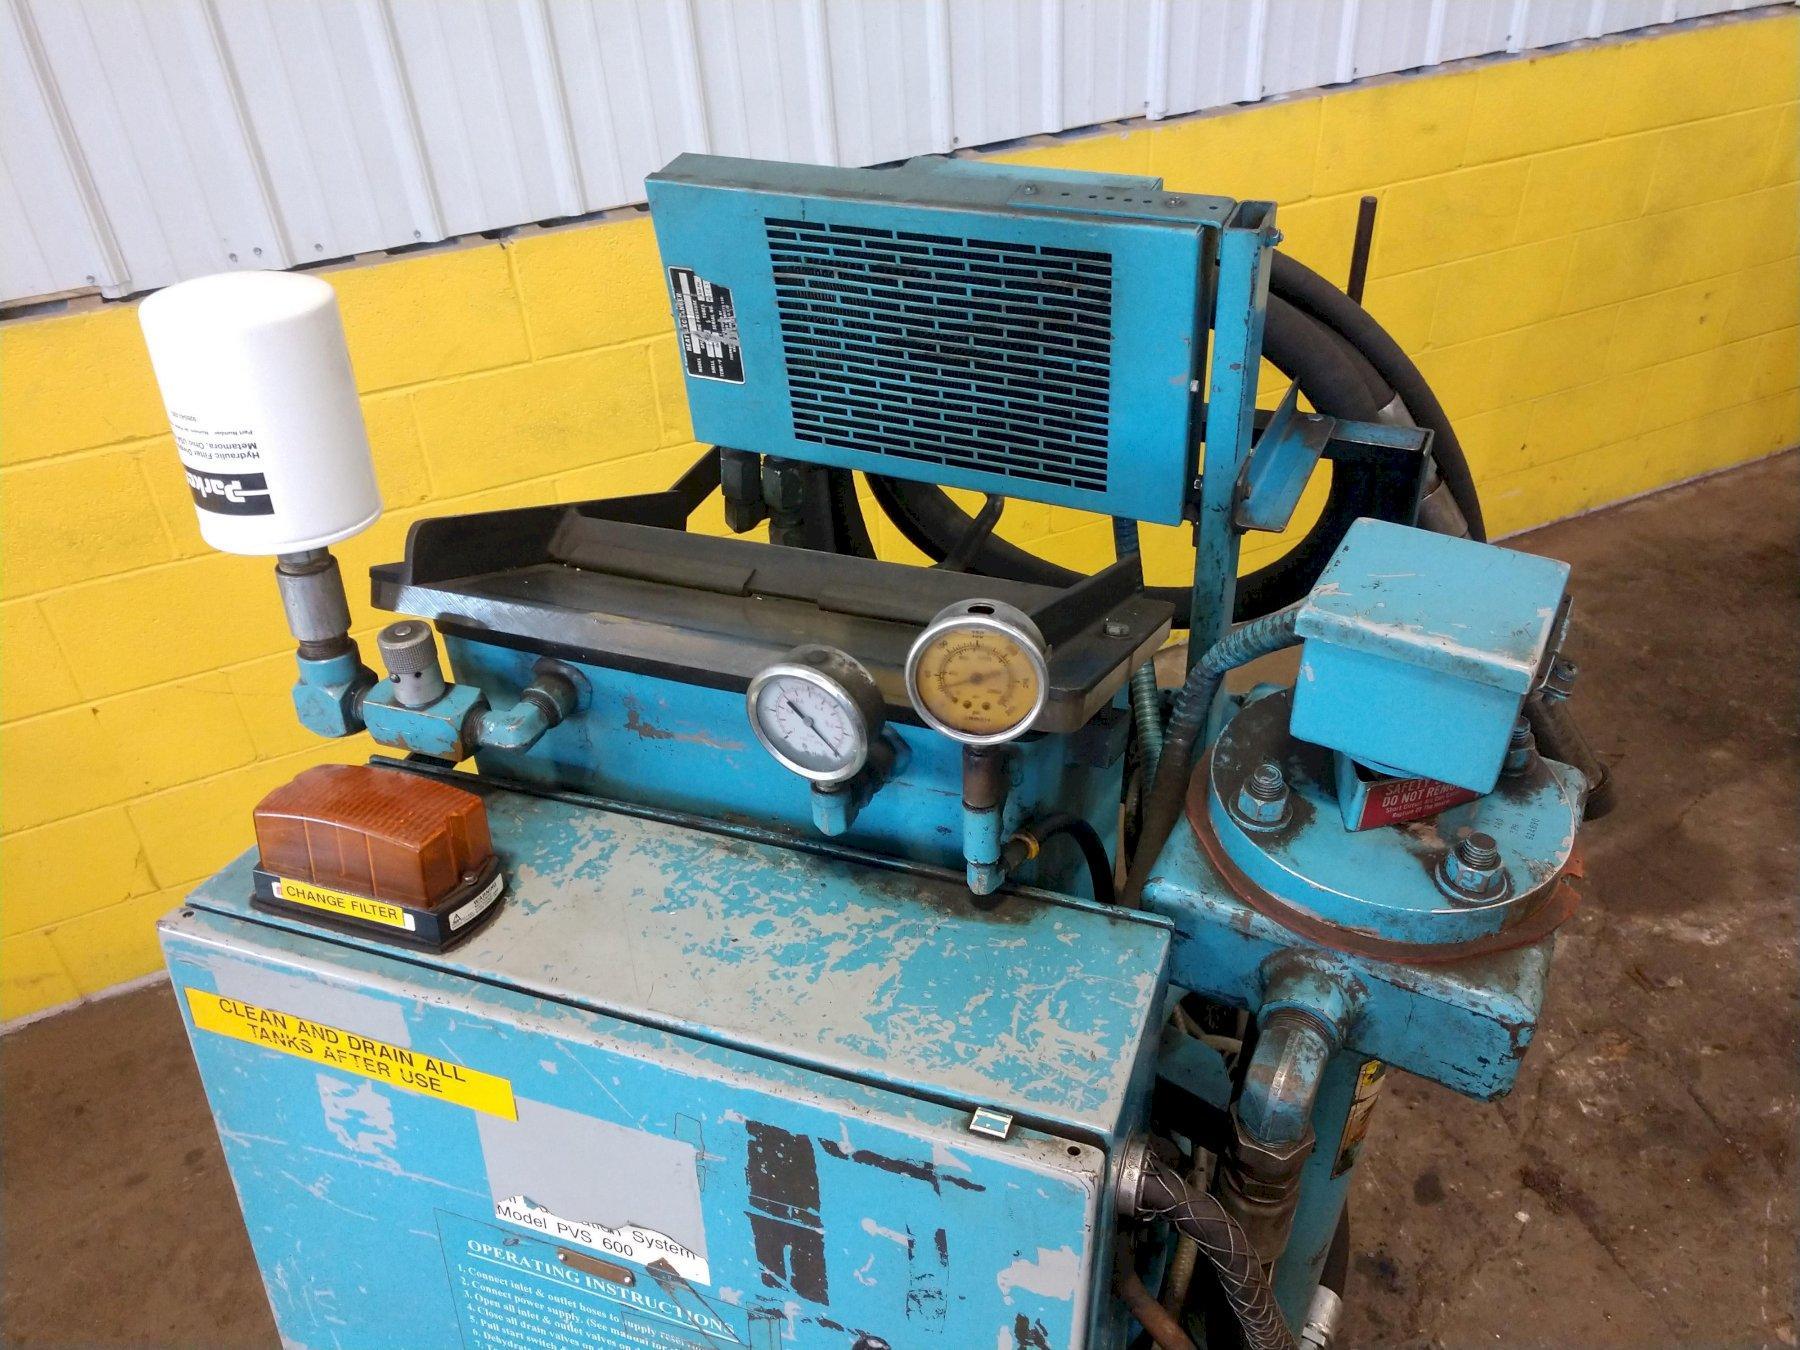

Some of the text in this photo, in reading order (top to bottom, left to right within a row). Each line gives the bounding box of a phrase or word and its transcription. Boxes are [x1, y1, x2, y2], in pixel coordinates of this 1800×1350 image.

[214, 451, 260, 460] Hydraulic
[187, 472, 246, 503] Parke
[1382, 795, 1398, 808] DO
[1401, 788, 1425, 804] NOT
[286, 885, 398, 920] CHANGE FILTER
[219, 998, 466, 1083] CLEAN AND DRAIN ALL
[247, 1023, 443, 1093] TANKS AFTER USE
[497, 1205, 548, 1229] Model
[557, 1222, 593, 1244] PVS
[602, 1237, 634, 1257] 600
[632, 1230, 696, 1260] System
[467, 1239, 735, 1334] OPERATING INSTRUCTIONS
[468, 1267, 508, 1287] Connect
[510, 1280, 533, 1294] inlet
[535, 1289, 545, 1298] &
[548, 1294, 577, 1309] outlet
[579, 1303, 607, 1319] hoses
[609, 1312, 620, 1322] to
[471, 1280, 512, 1299] Connect
[514, 1295, 544, 1310] power
[586, 1318, 608, 1331] (See
[475, 1293, 501, 1308] Open
[503, 1303, 516, 1314] all
[518, 1308, 540, 1321] inlet
[542, 1316, 552, 1325] &
[554, 1321, 583, 1336] outlet
[586, 1332, 617, 1348] valves
[477, 1306, 504, 1321] Close
[506, 1316, 518, 1326] all
[520, 1320, 547, 1336] drain
[549, 1331, 580, 1346] valves
[480, 1319, 500, 1332] Pull
[501, 1327, 524, 1340] start
